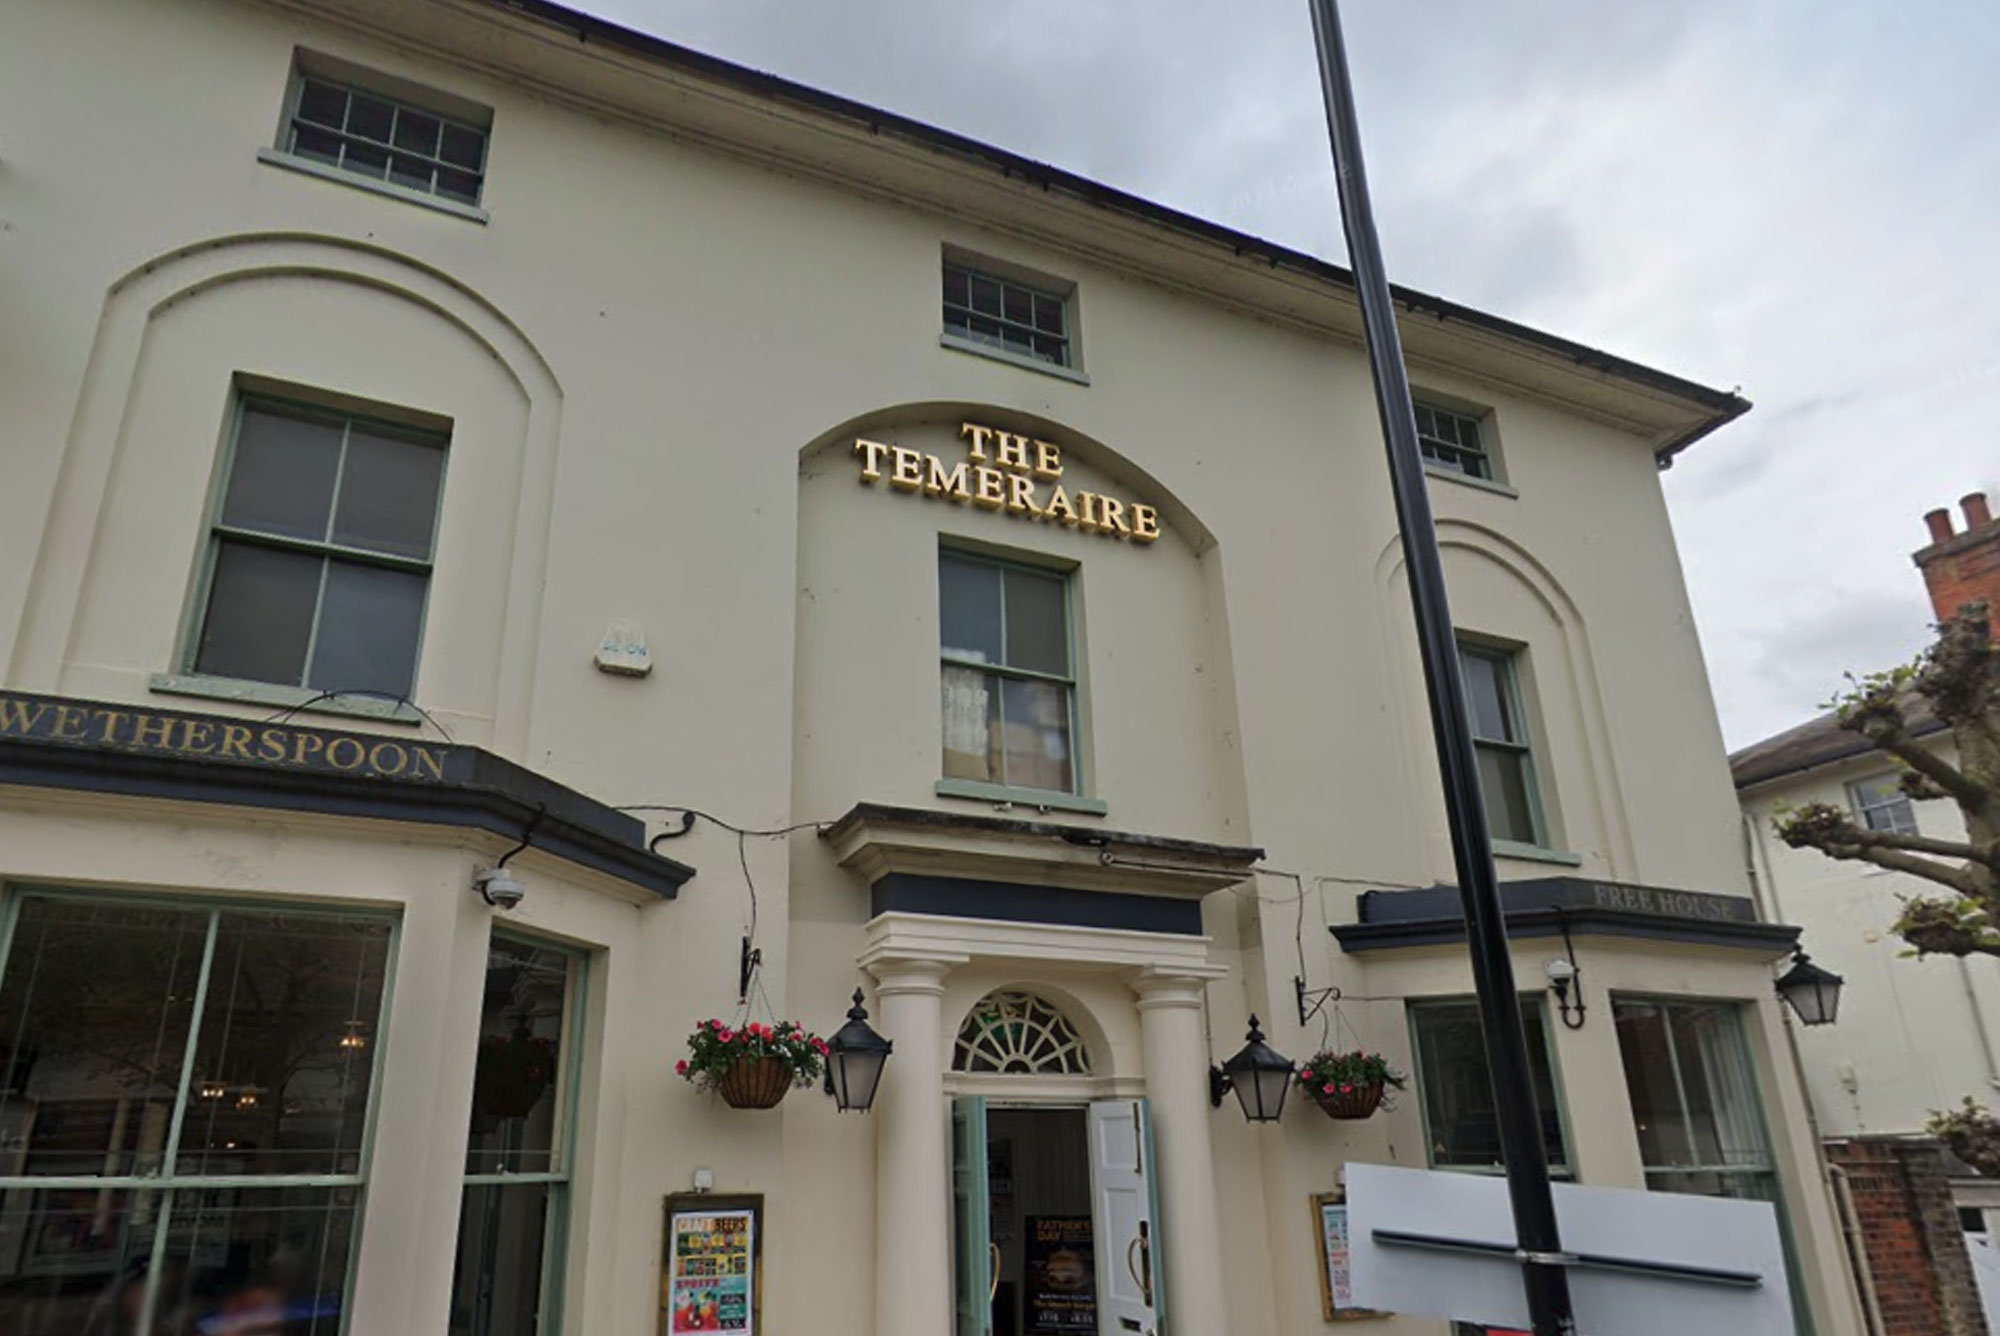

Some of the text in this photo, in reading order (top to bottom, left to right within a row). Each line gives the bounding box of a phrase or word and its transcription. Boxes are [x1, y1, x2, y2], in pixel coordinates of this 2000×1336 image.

[962, 422, 1065, 477] THE
[855, 438, 1160, 540] TEMERAIRE
[0, 700, 447, 780] WETHERSPOON
[1594, 884, 1734, 923] FREE HOUSE
